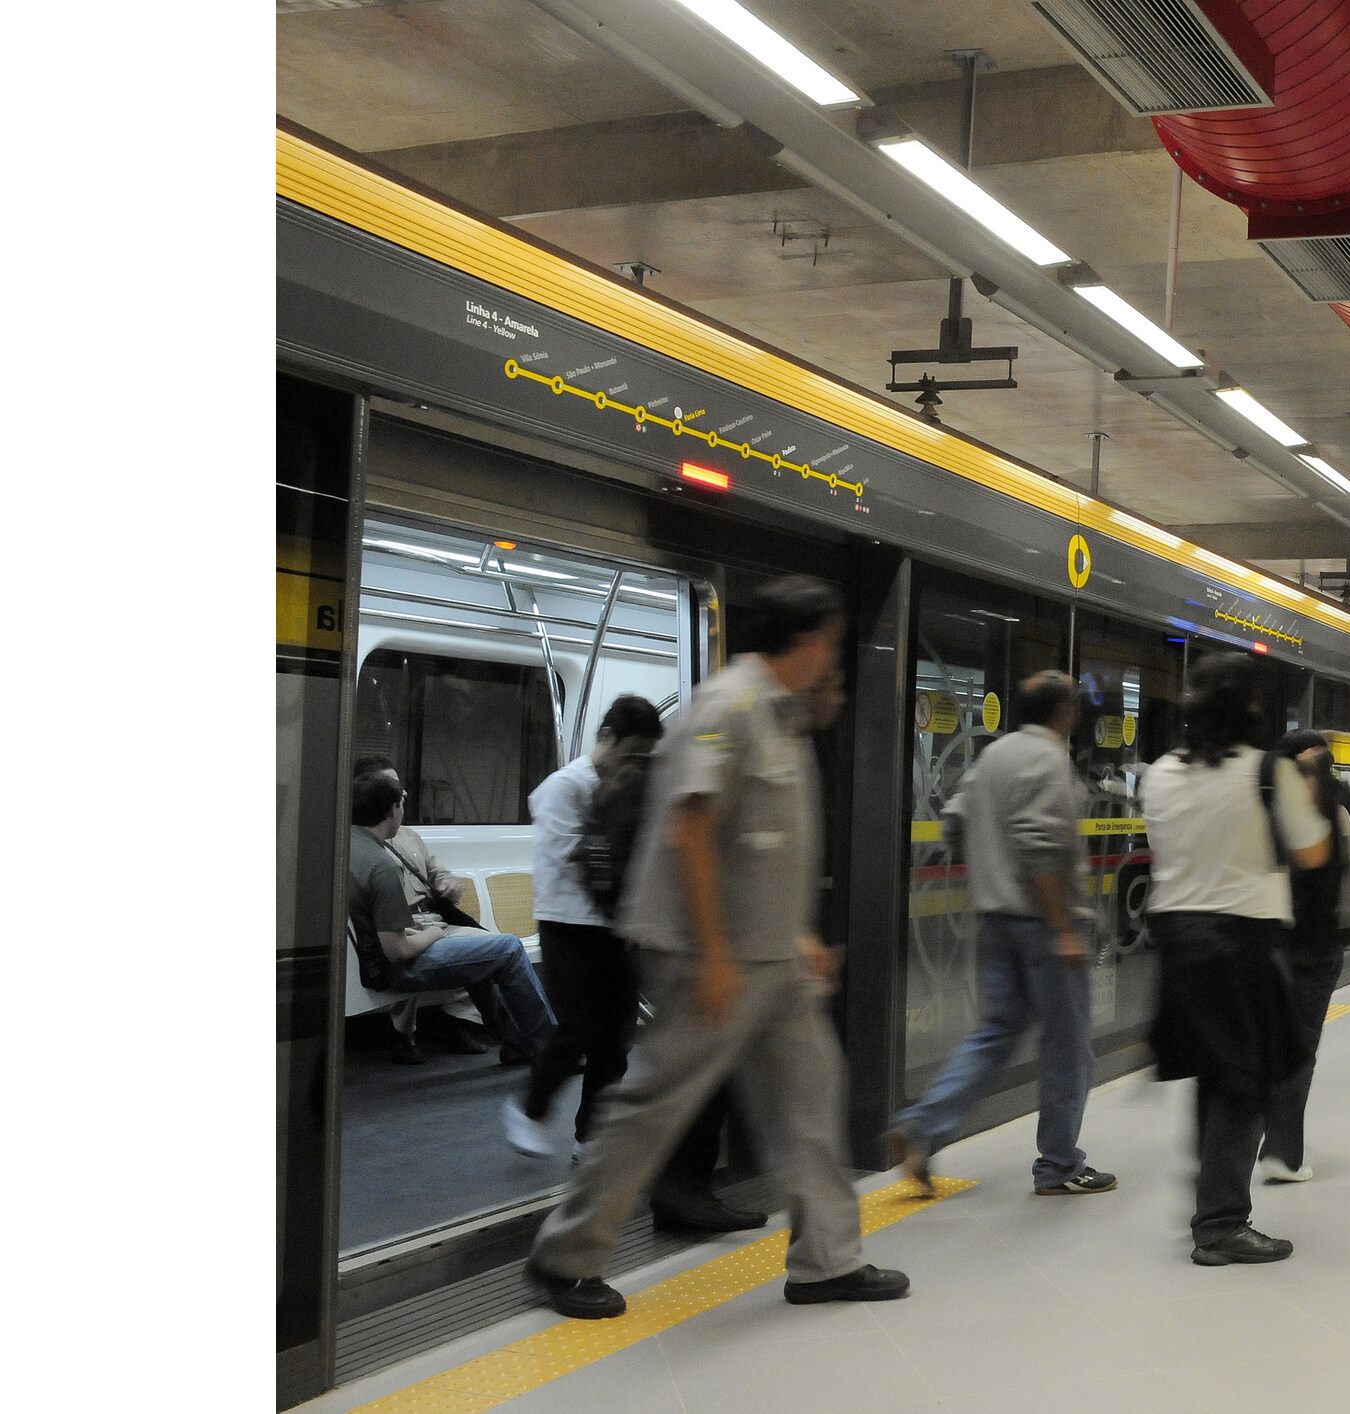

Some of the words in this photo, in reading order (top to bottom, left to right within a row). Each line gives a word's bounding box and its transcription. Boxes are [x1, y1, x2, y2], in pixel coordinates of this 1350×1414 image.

[466, 300, 490, 319] Linha
[491, 311, 498, 322] 4
[504, 315, 539, 338] Amarela
[466, 314, 482, 328] Line
[482, 321, 488, 330] 4
[493, 324, 516, 340] Yellow
